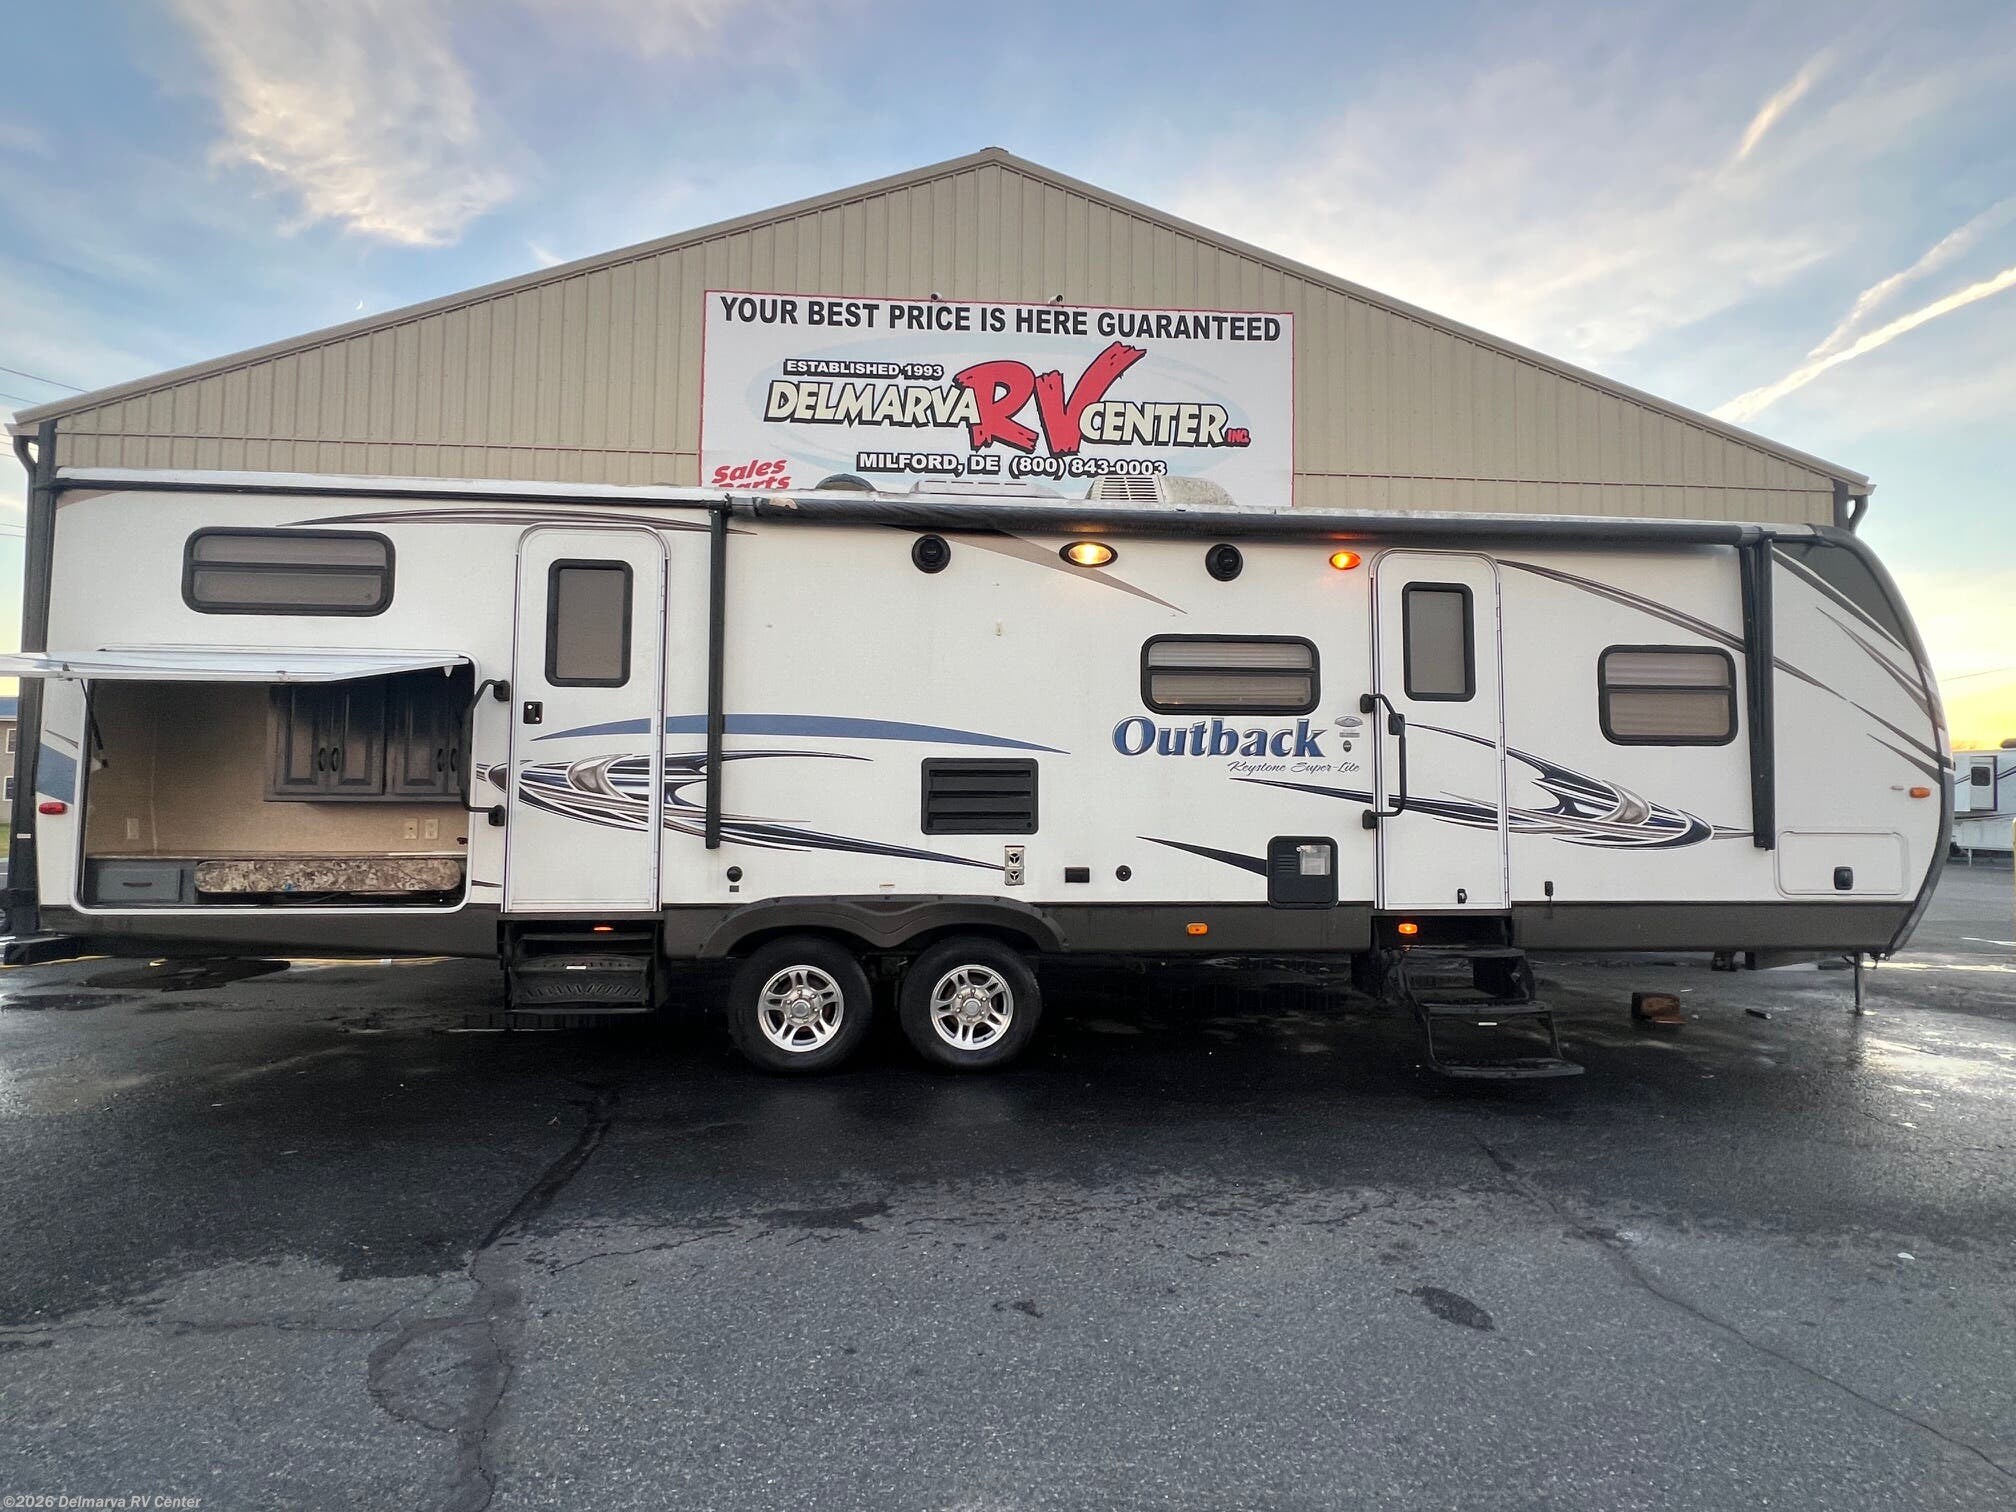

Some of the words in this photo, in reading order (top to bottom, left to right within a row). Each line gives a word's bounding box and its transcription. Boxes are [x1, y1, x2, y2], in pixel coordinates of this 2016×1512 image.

[720, 296, 798, 324] YOUR
[808, 301, 879, 328] BEST
[889, 304, 971, 331] PRICE
[981, 307, 1006, 332] IS
[1016, 309, 1088, 335] HERE
[1097, 313, 1281, 341] GUARANTEED
[785, 359, 900, 377] ESTABLISHED
[903, 364, 944, 378] 1993
[765, 381, 981, 427] DELMARVA
[954, 341, 1147, 454] RV
[1079, 401, 1228, 446] CENTER
[1225, 428, 1250, 446] INC.
[712, 459, 787, 483] Sales
[858, 453, 965, 475] MILFORD,
[970, 457, 1000, 473] DE
[1011, 457, 1066, 478] (800)
[1070, 459, 1168, 476] 843-0003
[1112, 716, 1328, 758] Outback
[1229, 761, 1286, 775] Keystone
[1290, 761, 1360, 775] Super-Lite
